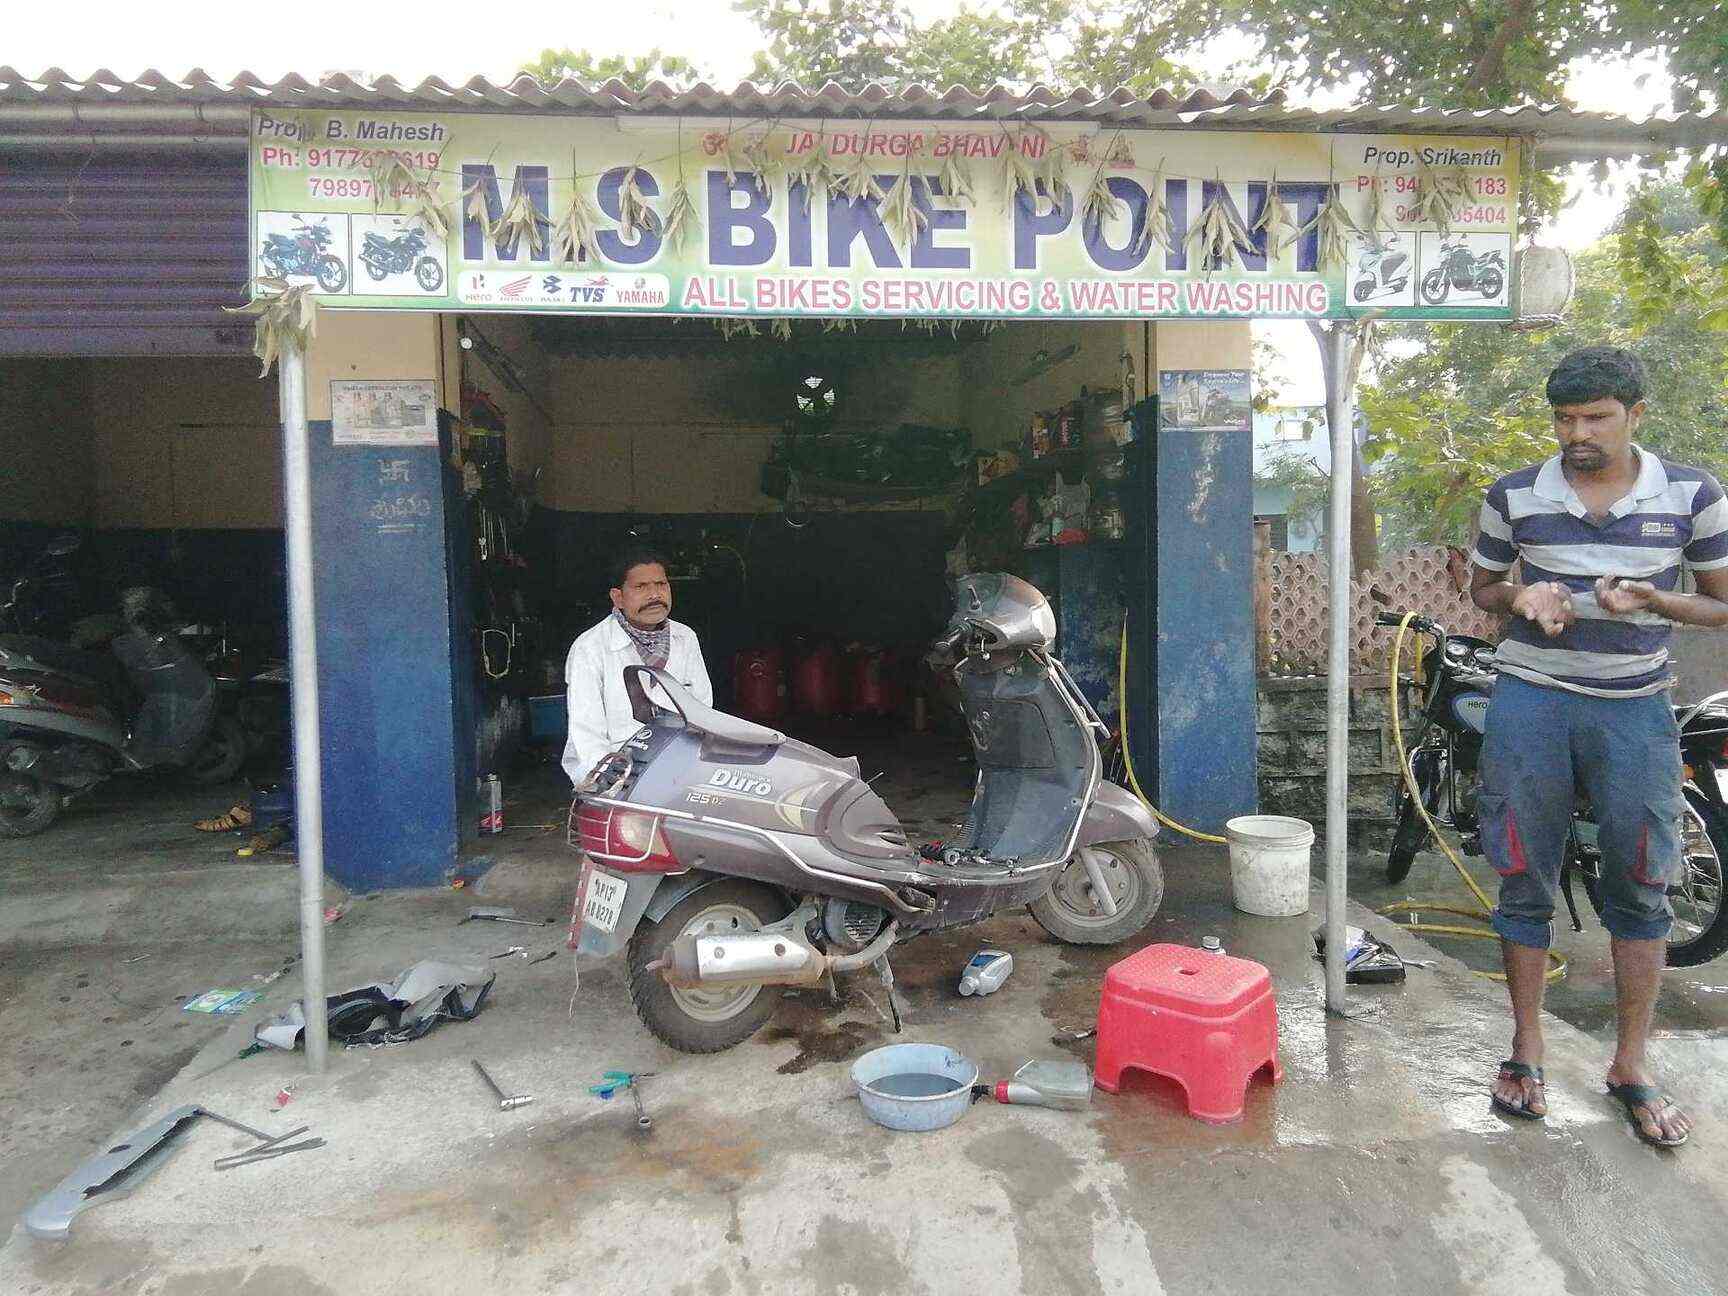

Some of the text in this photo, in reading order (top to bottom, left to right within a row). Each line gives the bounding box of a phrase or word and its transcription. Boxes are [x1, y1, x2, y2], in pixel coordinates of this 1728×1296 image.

[326, 120, 348, 138] B.
[356, 120, 444, 141] Mahesh
[263, 147, 300, 166] Ph:
[831, 134, 925, 156] DURGA
[933, 135, 1048, 160] BHAVNI
[1364, 146, 1502, 168] Prop. Srikanth
[707, 170, 971, 269] BIKE
[1013, 176, 1340, 272] POINT
[570, 287, 605, 302] TVS
[616, 290, 665, 304] YAMAHA
[684, 277, 1327, 313] ALL BIKES SERVICING & WATER WASHING
[709, 768, 772, 796] Duro
